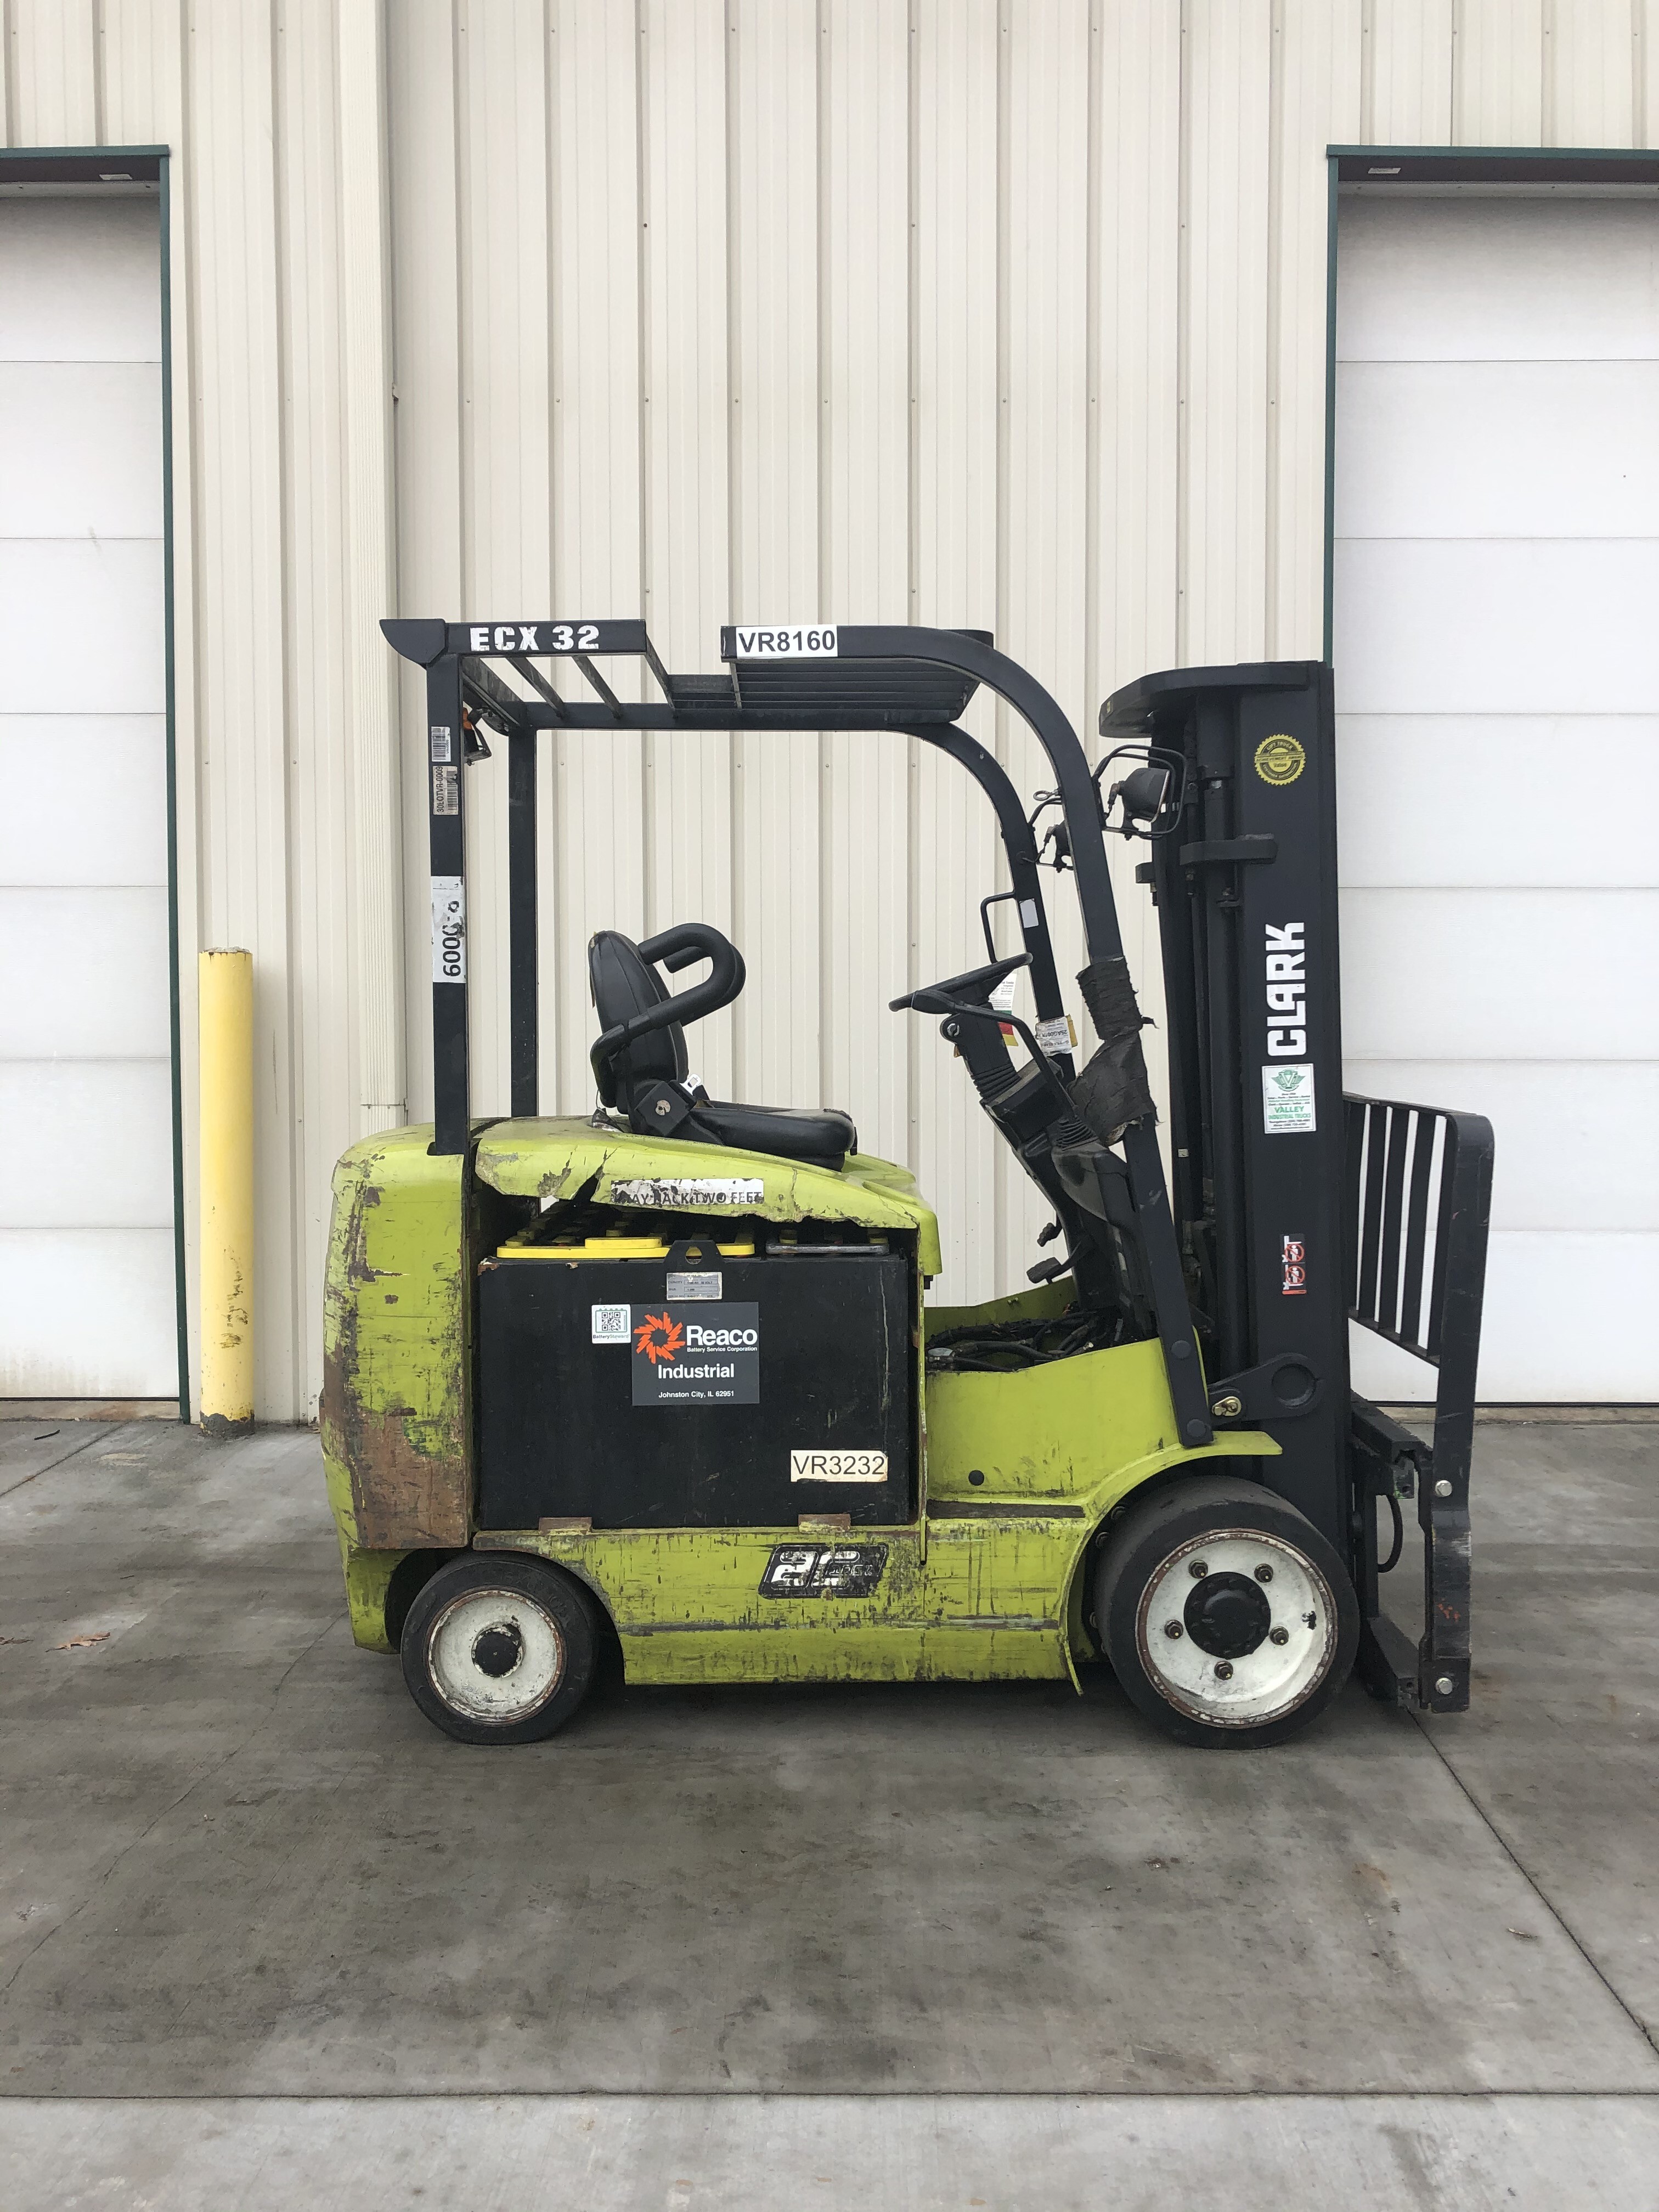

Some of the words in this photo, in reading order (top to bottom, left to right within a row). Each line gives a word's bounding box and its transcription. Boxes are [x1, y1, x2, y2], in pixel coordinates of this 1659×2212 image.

[470, 626, 539, 652] ECX
[552, 625, 599, 650] 32
[738, 630, 835, 653] VR8160
[1265, 922, 1306, 1056] CLARK
[686, 1325, 758, 1346] Reaco
[658, 1363, 735, 1379] Industrial
[793, 1455, 884, 1475] VR3232
